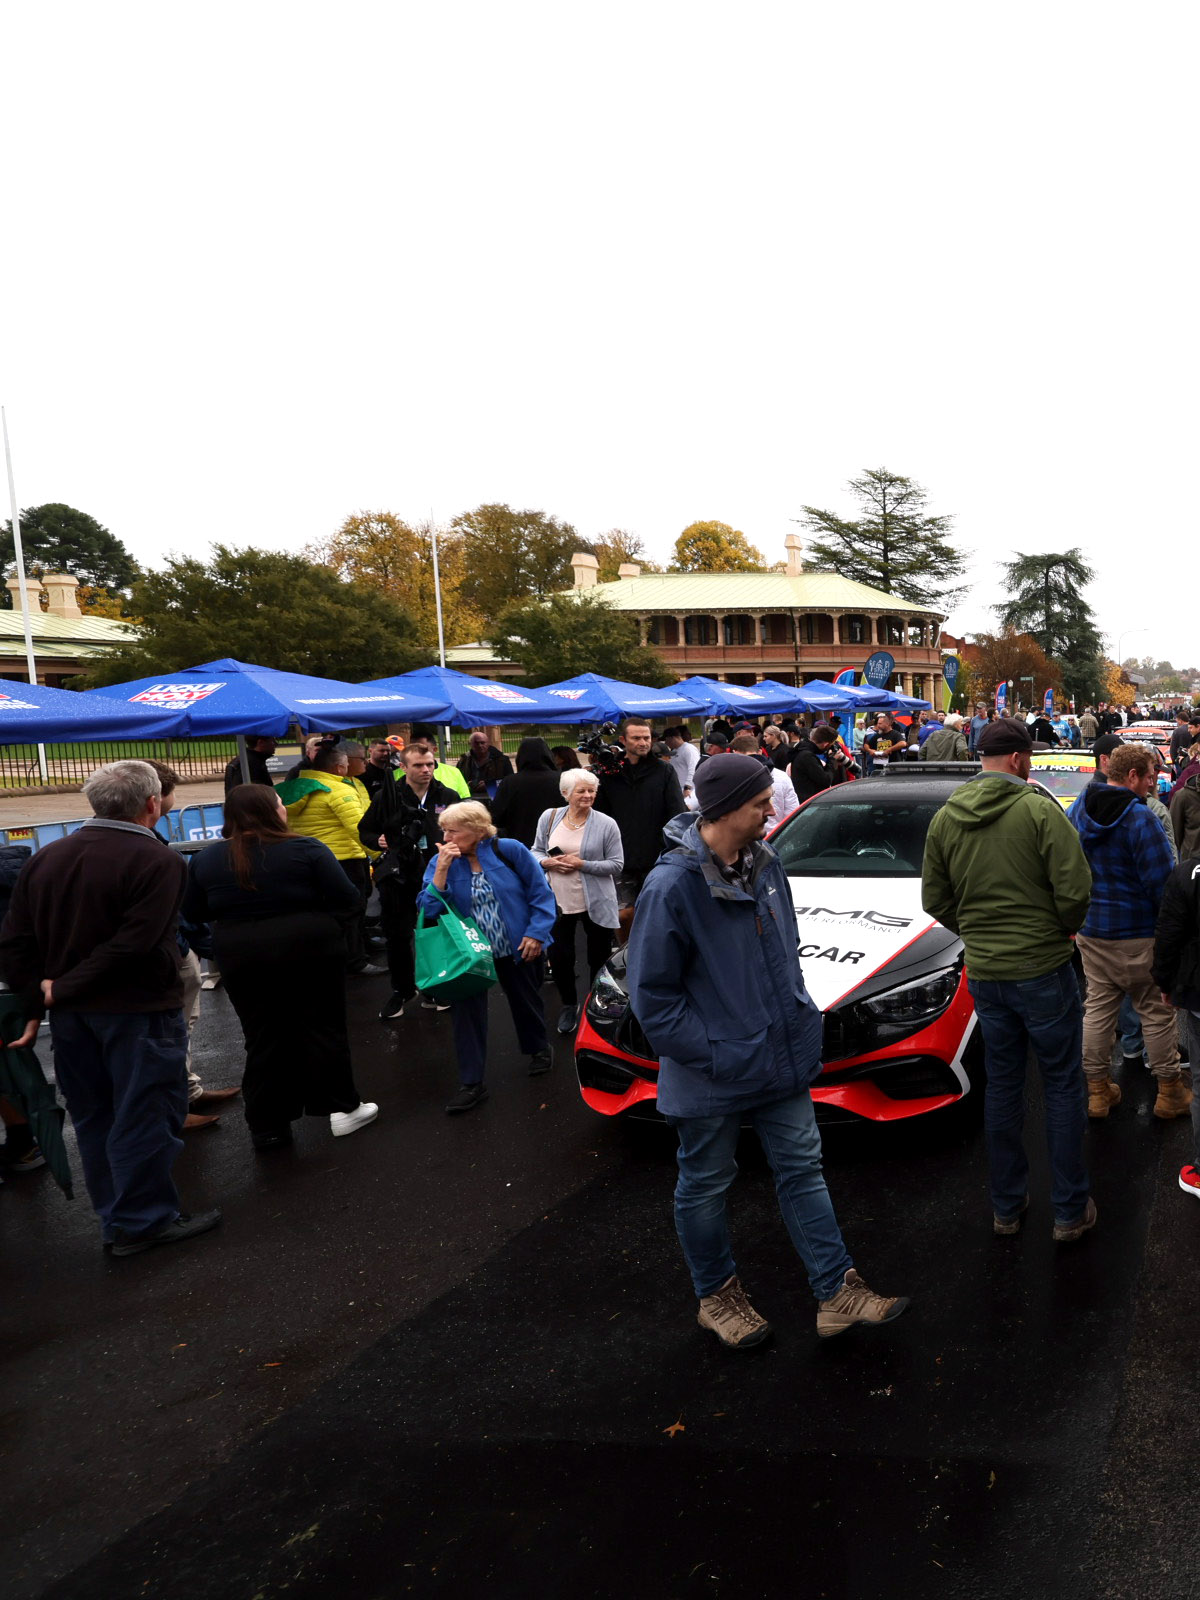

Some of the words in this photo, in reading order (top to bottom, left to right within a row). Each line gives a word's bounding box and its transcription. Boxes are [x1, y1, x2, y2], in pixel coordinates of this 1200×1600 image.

[148, 684, 217, 693] LIQUI
[138, 692, 212, 701] MOLY
[797, 945, 866, 965] CAR
